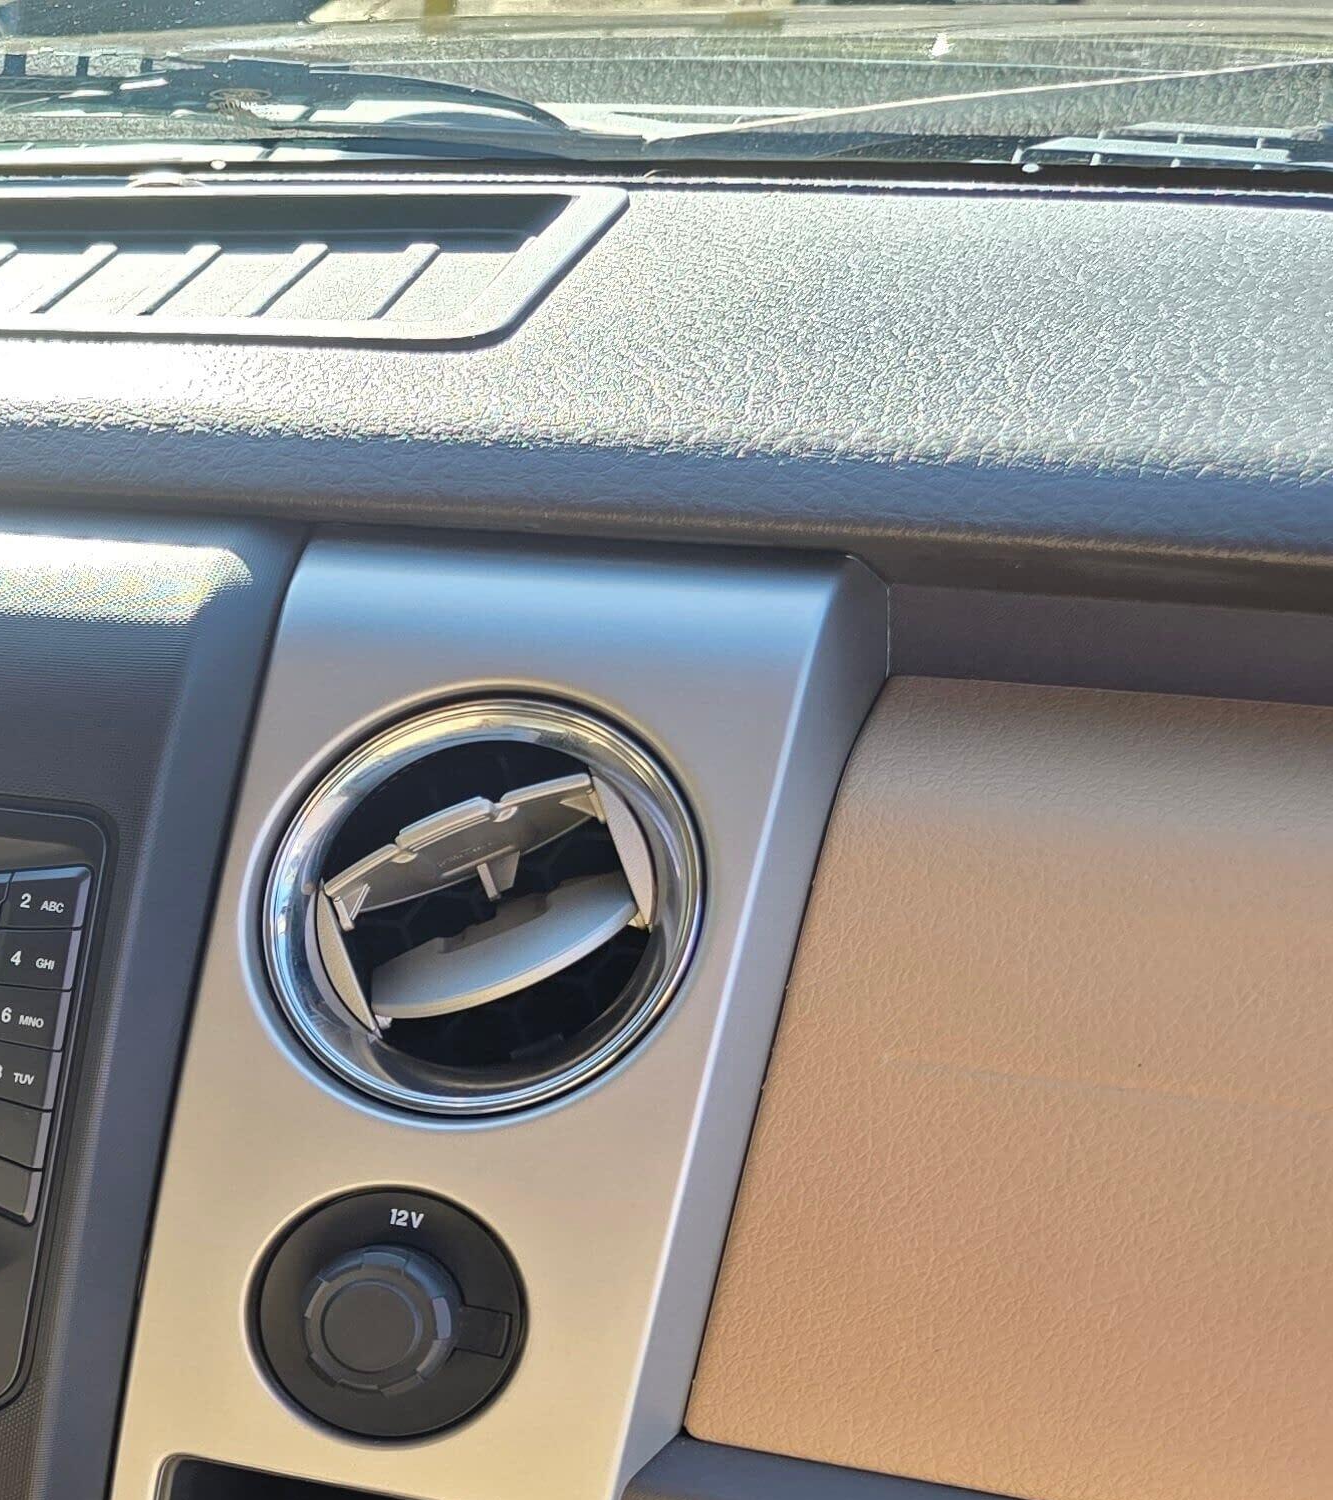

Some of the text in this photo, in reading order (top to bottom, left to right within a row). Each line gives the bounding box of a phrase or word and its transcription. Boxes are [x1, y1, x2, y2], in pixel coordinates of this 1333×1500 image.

[20, 893, 65, 914] 2 ABC
[10, 950, 56, 971] 4 GHI
[1, 1006, 45, 1029] 6 MNO
[13, 1072, 35, 1086] TUV
[389, 1208, 425, 1230] 12V
